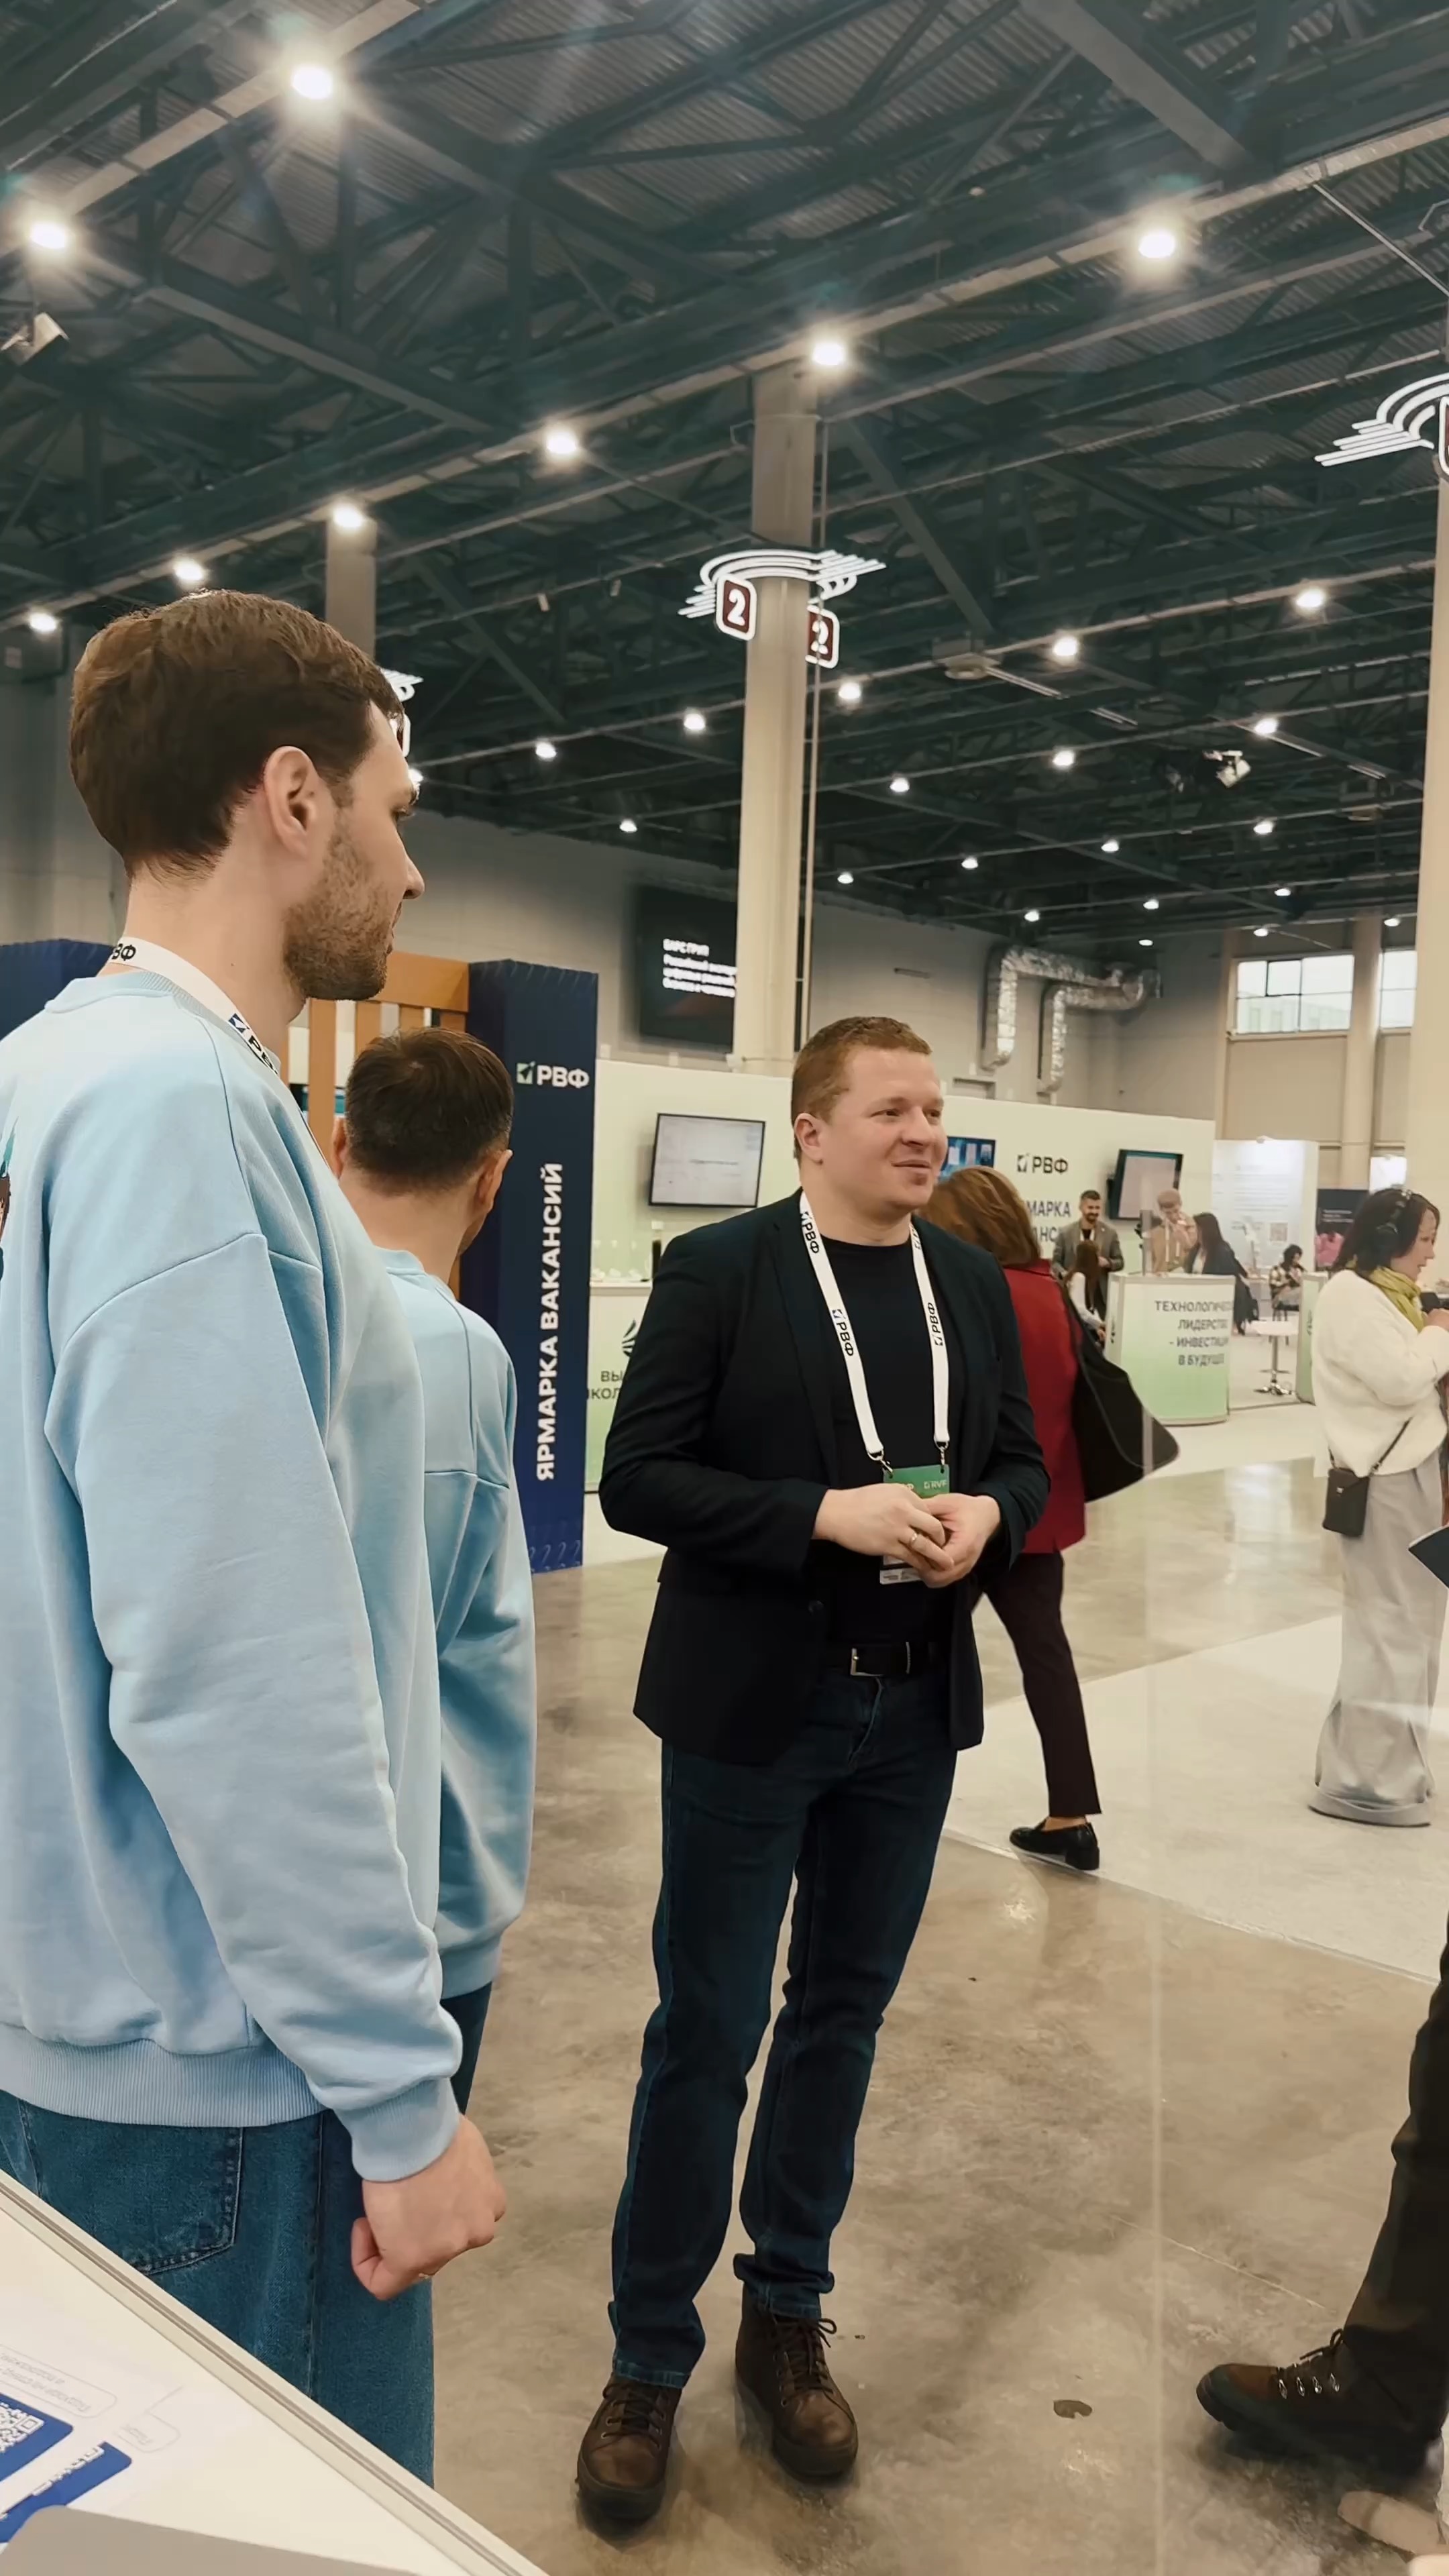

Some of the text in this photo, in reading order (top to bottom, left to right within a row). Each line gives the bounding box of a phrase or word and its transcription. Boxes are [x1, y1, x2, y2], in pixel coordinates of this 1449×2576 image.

[728, 589, 745, 626] 2
[811, 621, 828, 654] 2
[248, 1035, 278, 1075] РВ
[537, 1065, 590, 1089] РВФ
[1032, 1156, 1069, 1175] РВФ
[802, 1222, 820, 1254] РВФ
[537, 1163, 563, 1481] ЯРМАРКА ВАКАНСИЙ
[928, 1302, 941, 1334] РВФ
[837, 1322, 854, 1356] РВФ
[588, 1387, 620, 1400] КОЛ
